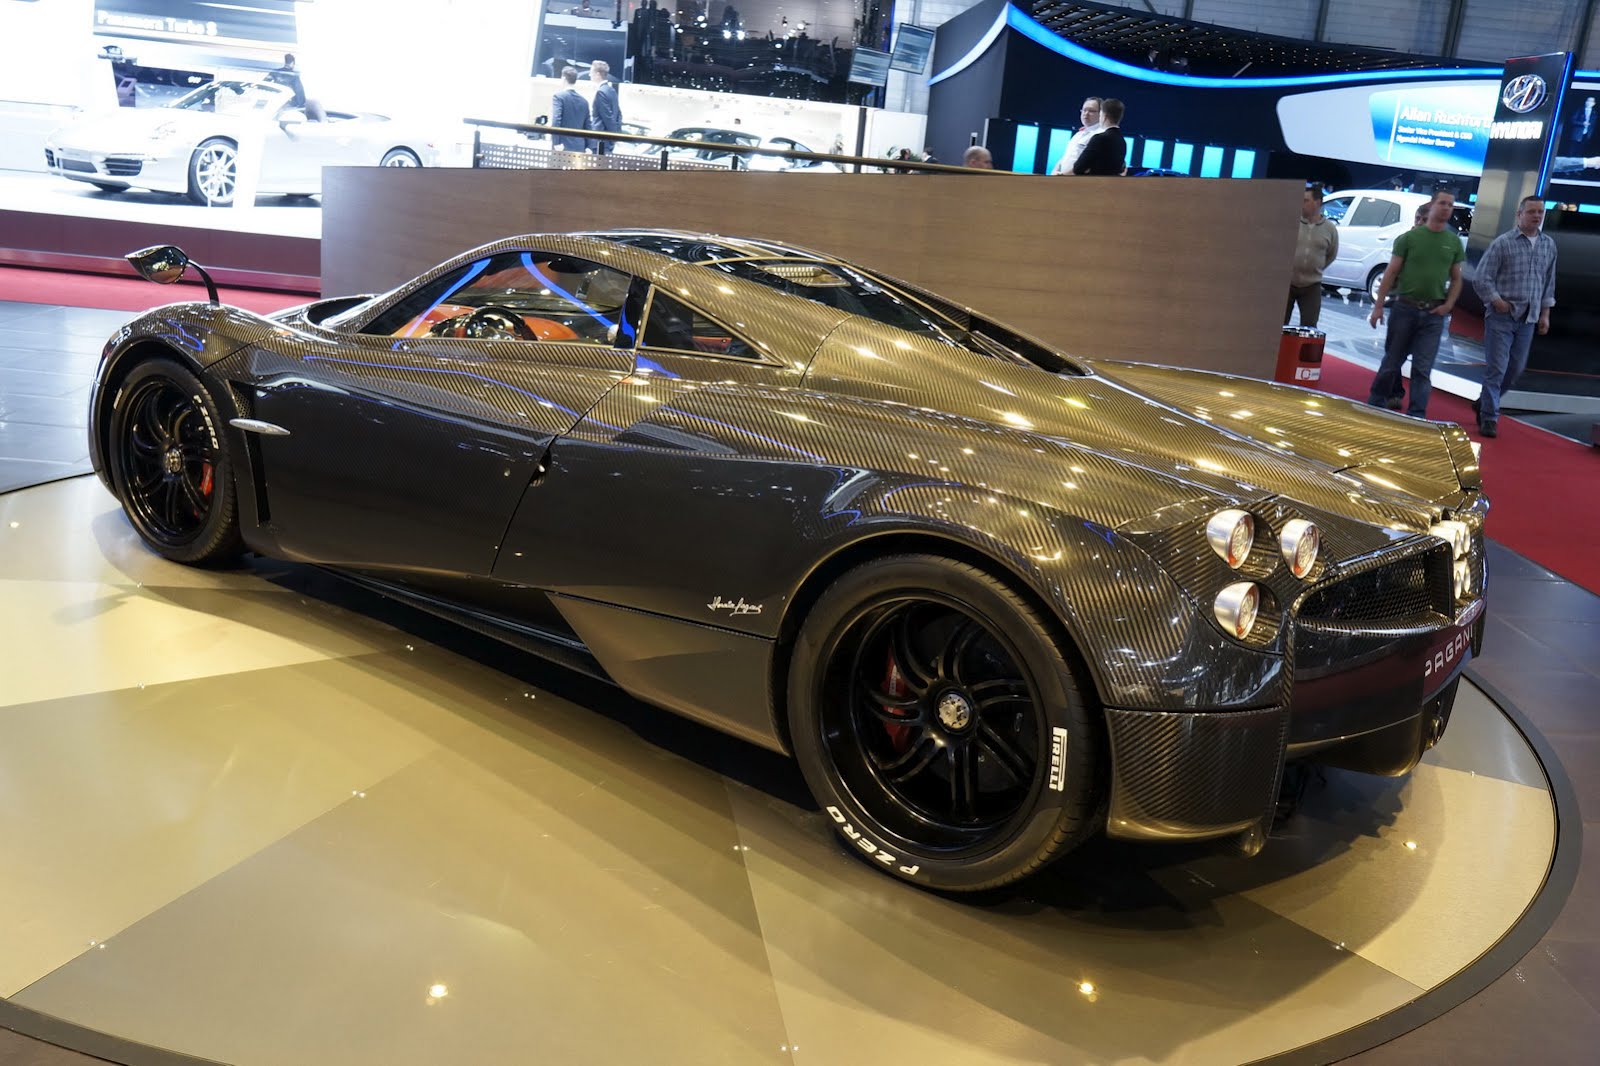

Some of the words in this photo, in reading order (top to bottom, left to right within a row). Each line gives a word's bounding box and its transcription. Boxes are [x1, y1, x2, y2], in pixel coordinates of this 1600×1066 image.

[1489, 121, 1543, 139] HYUNDAI
[1424, 623, 1474, 678] PAGANI
[1048, 726, 1068, 792] PIRELLI
[826, 805, 897, 866] ZERO
[899, 864, 920, 876] P
